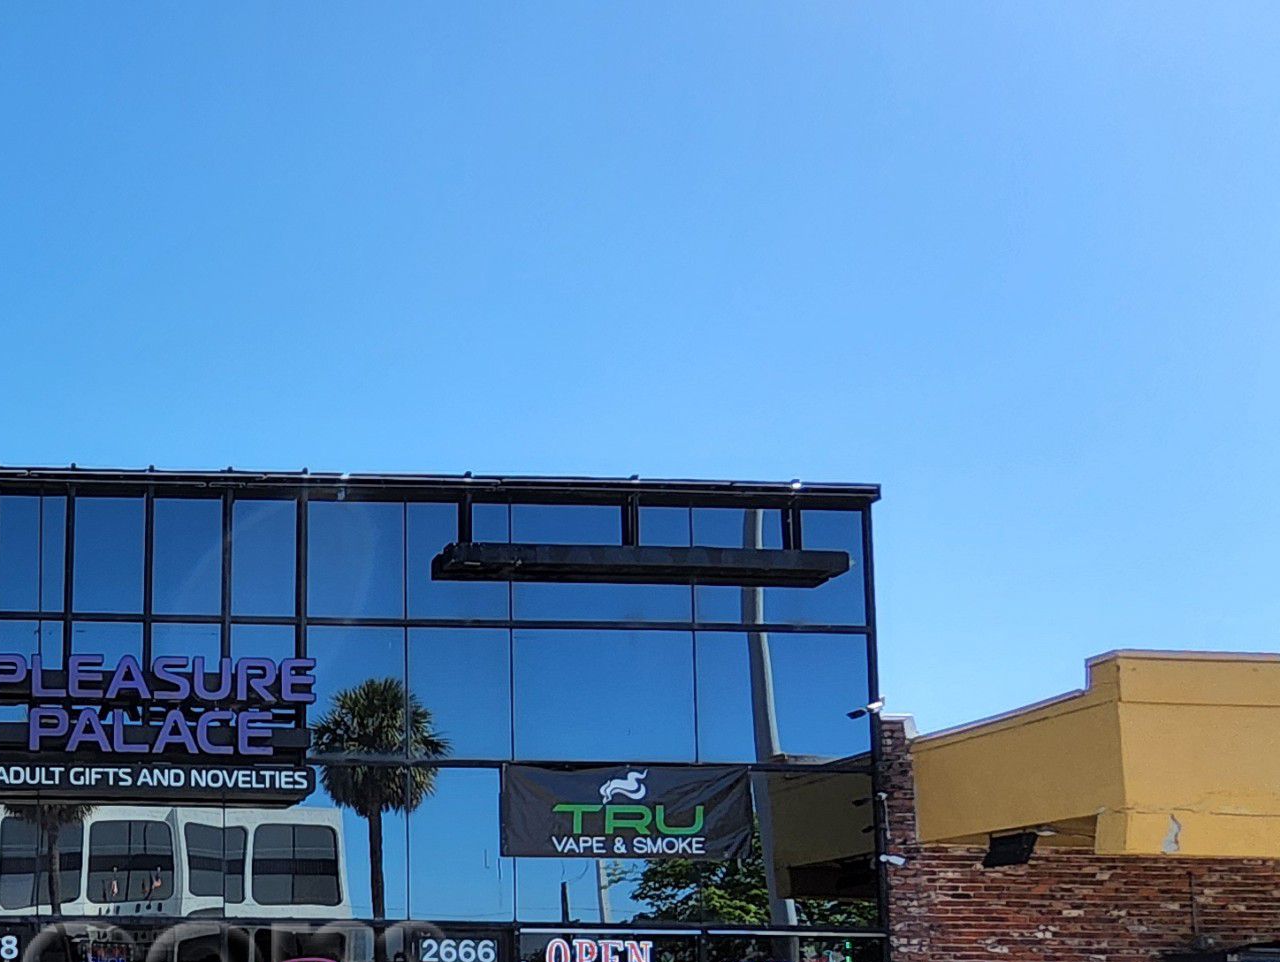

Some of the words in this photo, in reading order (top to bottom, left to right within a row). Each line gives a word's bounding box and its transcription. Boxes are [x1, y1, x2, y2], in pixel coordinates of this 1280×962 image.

[28, 708, 274, 756] PALACE
[70, 767, 132, 787] GIFTS
[137, 768, 185, 788] AND
[190, 769, 308, 790] NOVELTIES
[552, 804, 705, 835] TRU
[552, 836, 606, 854] VAPE
[614, 837, 627, 854] &
[632, 836, 706, 854] SMOKE
